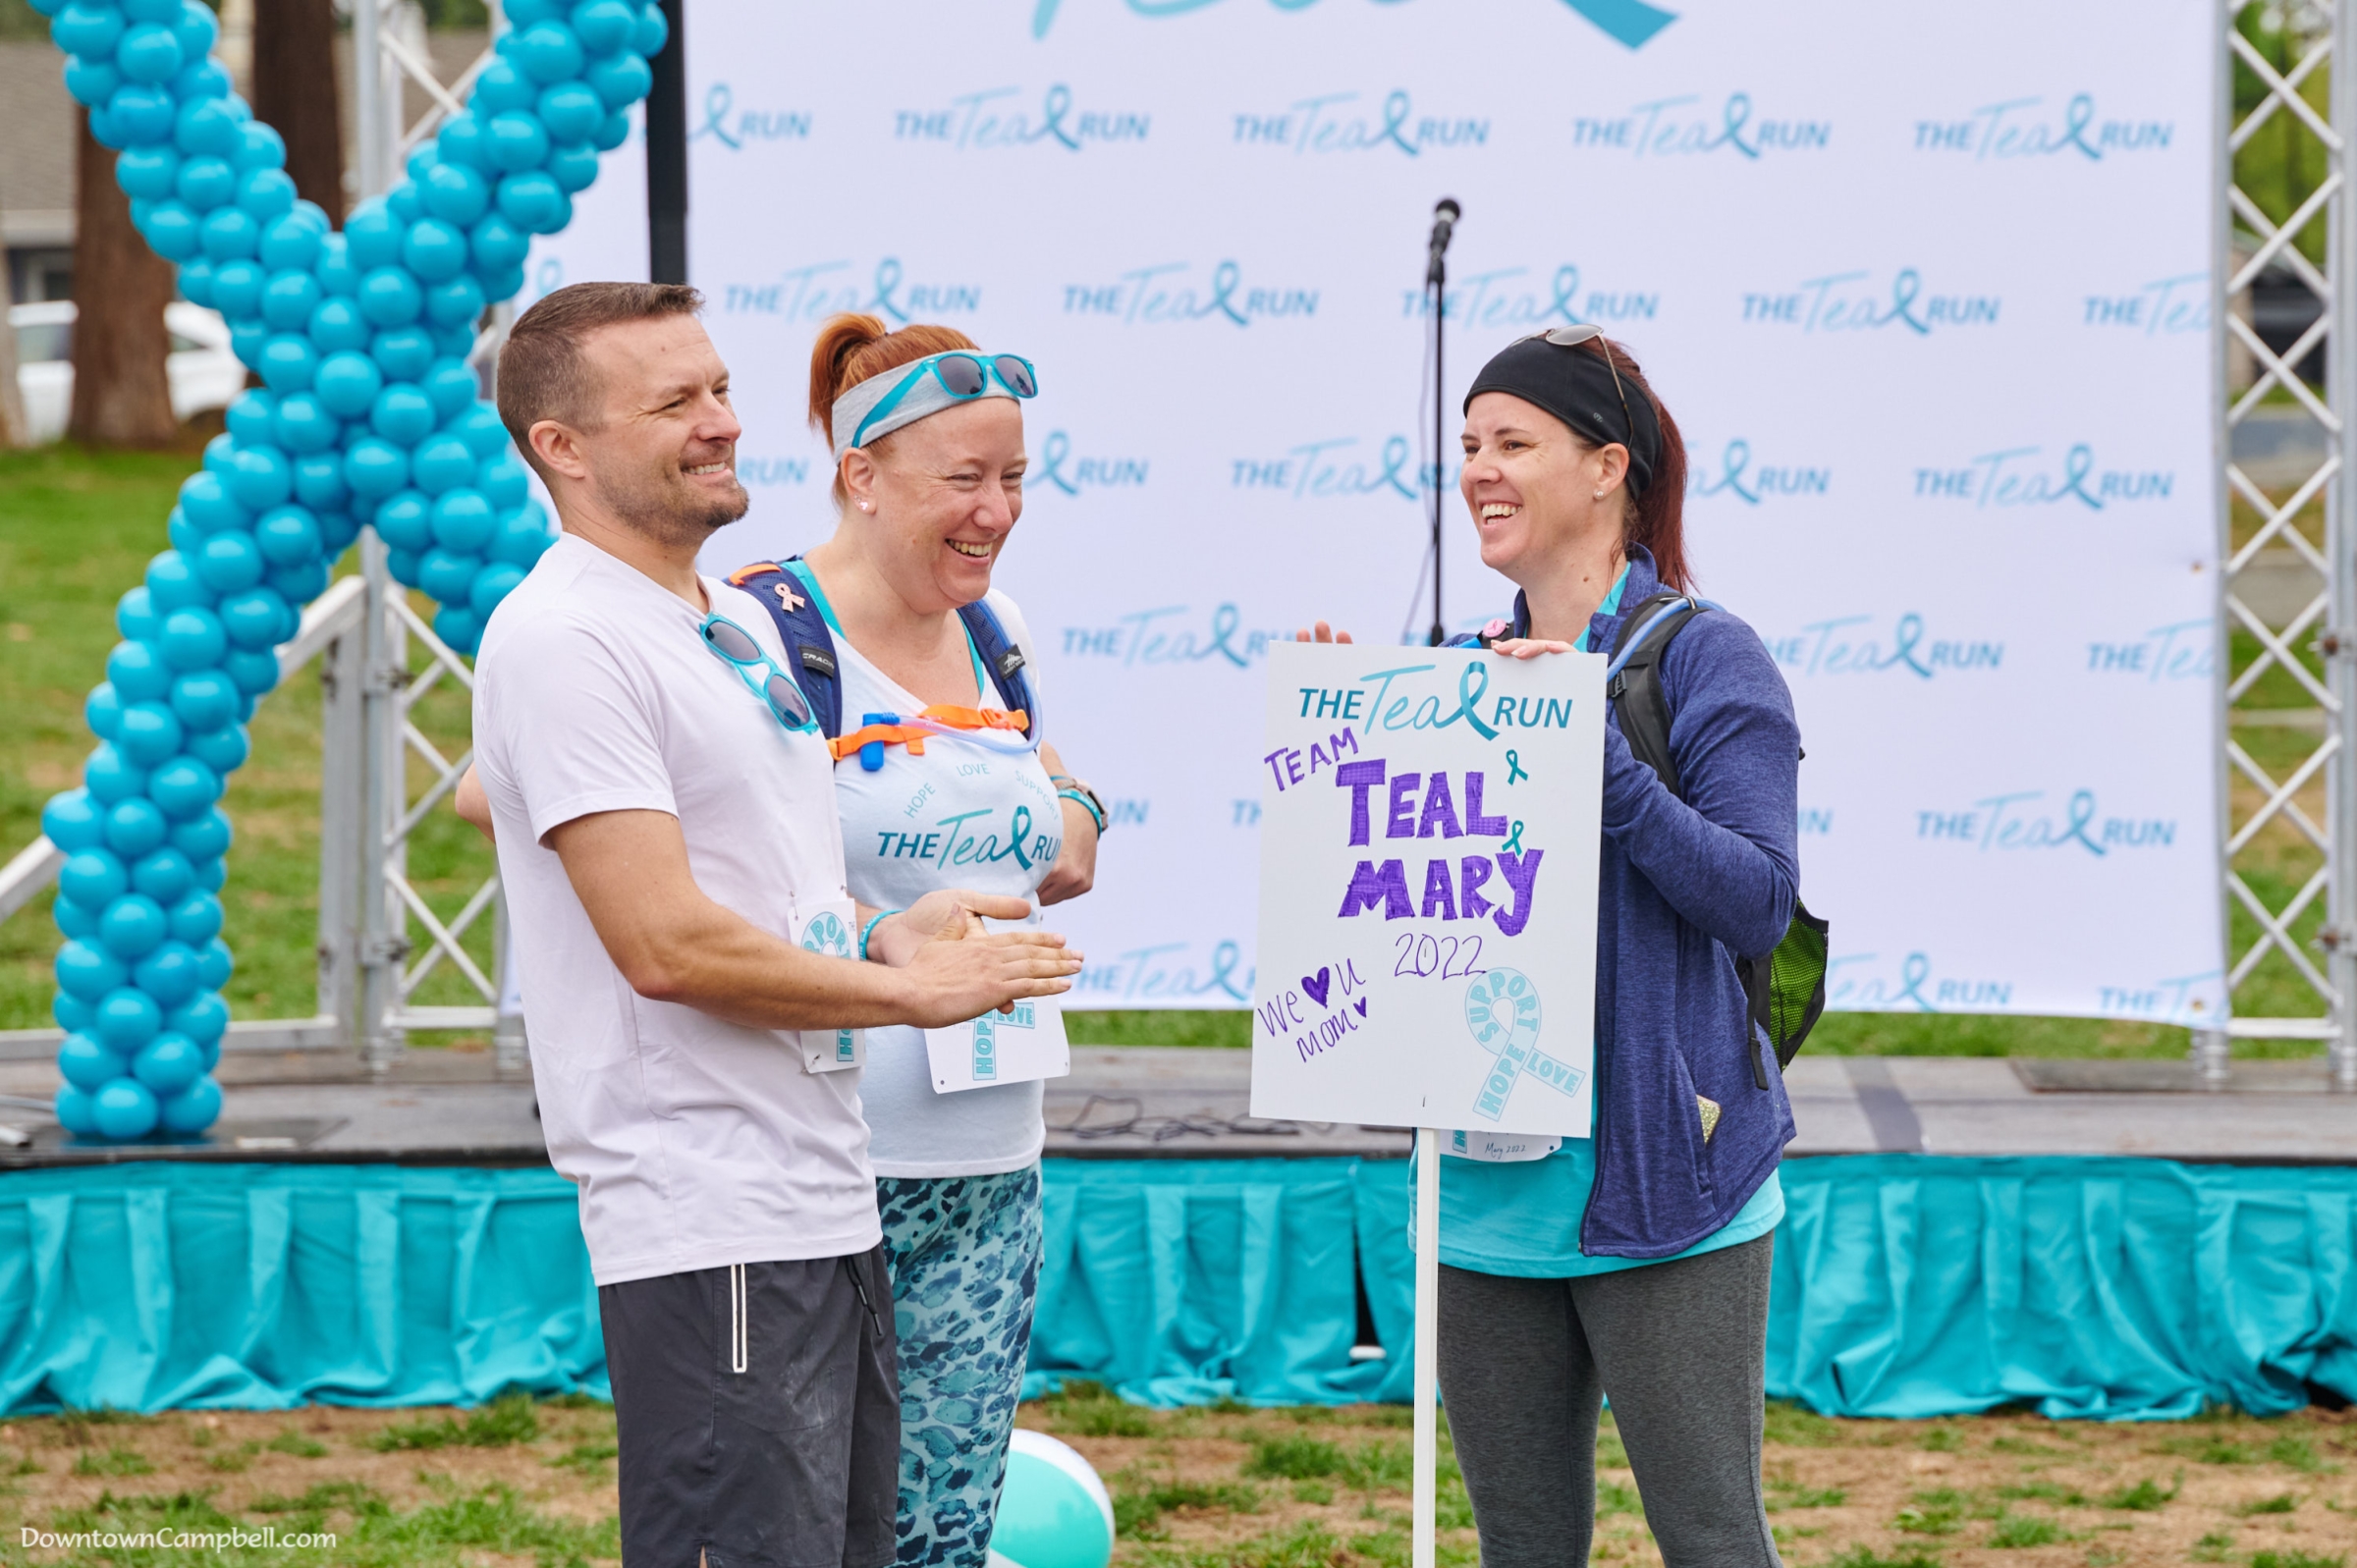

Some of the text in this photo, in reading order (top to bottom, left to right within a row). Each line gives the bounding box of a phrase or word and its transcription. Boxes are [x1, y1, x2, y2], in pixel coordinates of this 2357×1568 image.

[740, 112, 811, 139] RUN
[894, 111, 952, 139] THE
[1079, 114, 1151, 141] RUN
[1233, 114, 1291, 142] THE
[1415, 119, 1491, 146] RUN
[1571, 117, 1631, 146] THE
[1756, 121, 1831, 148] RUN
[1913, 121, 1974, 149] THE
[2100, 122, 2173, 149] RUN
[724, 285, 784, 313] THE
[907, 287, 980, 312] RUN
[1064, 286, 1124, 314] THE
[1245, 289, 1320, 318] RUN
[1585, 294, 1660, 320] RUN
[1740, 294, 1801, 322] THE
[1926, 296, 2001, 325] RUN
[2082, 296, 2144, 325] THE
[1077, 460, 1149, 487] RUN
[1231, 460, 1291, 489] THE
[1757, 467, 1831, 495] RUN
[1913, 468, 1975, 498] THE
[2100, 471, 2174, 499] RUN
[1062, 627, 1123, 657] THE
[1929, 641, 2004, 670] RUN
[2086, 641, 2148, 671] THE
[1298, 661, 1573, 741] THE Teal RUN
[956, 763, 991, 777] LOVE
[1264, 726, 1360, 792] TEAM
[904, 783, 936, 819] HOPE
[1014, 770, 1059, 821] SUPPORT
[1336, 758, 1508, 847] TEAL
[876, 832, 941, 858] THE
[935, 805, 1033, 871] Teal
[1916, 811, 1977, 840] THE
[2103, 819, 2177, 848] RUN
[1337, 848, 1546, 937] MARY
[1395, 932, 1488, 980] 2022
[1469, 971, 1539, 1043] SUPPORT
[1937, 978, 2012, 1006] RUN
[1479, 1043, 1526, 1115] HOPE
[1527, 1053, 1579, 1094] LOVE
